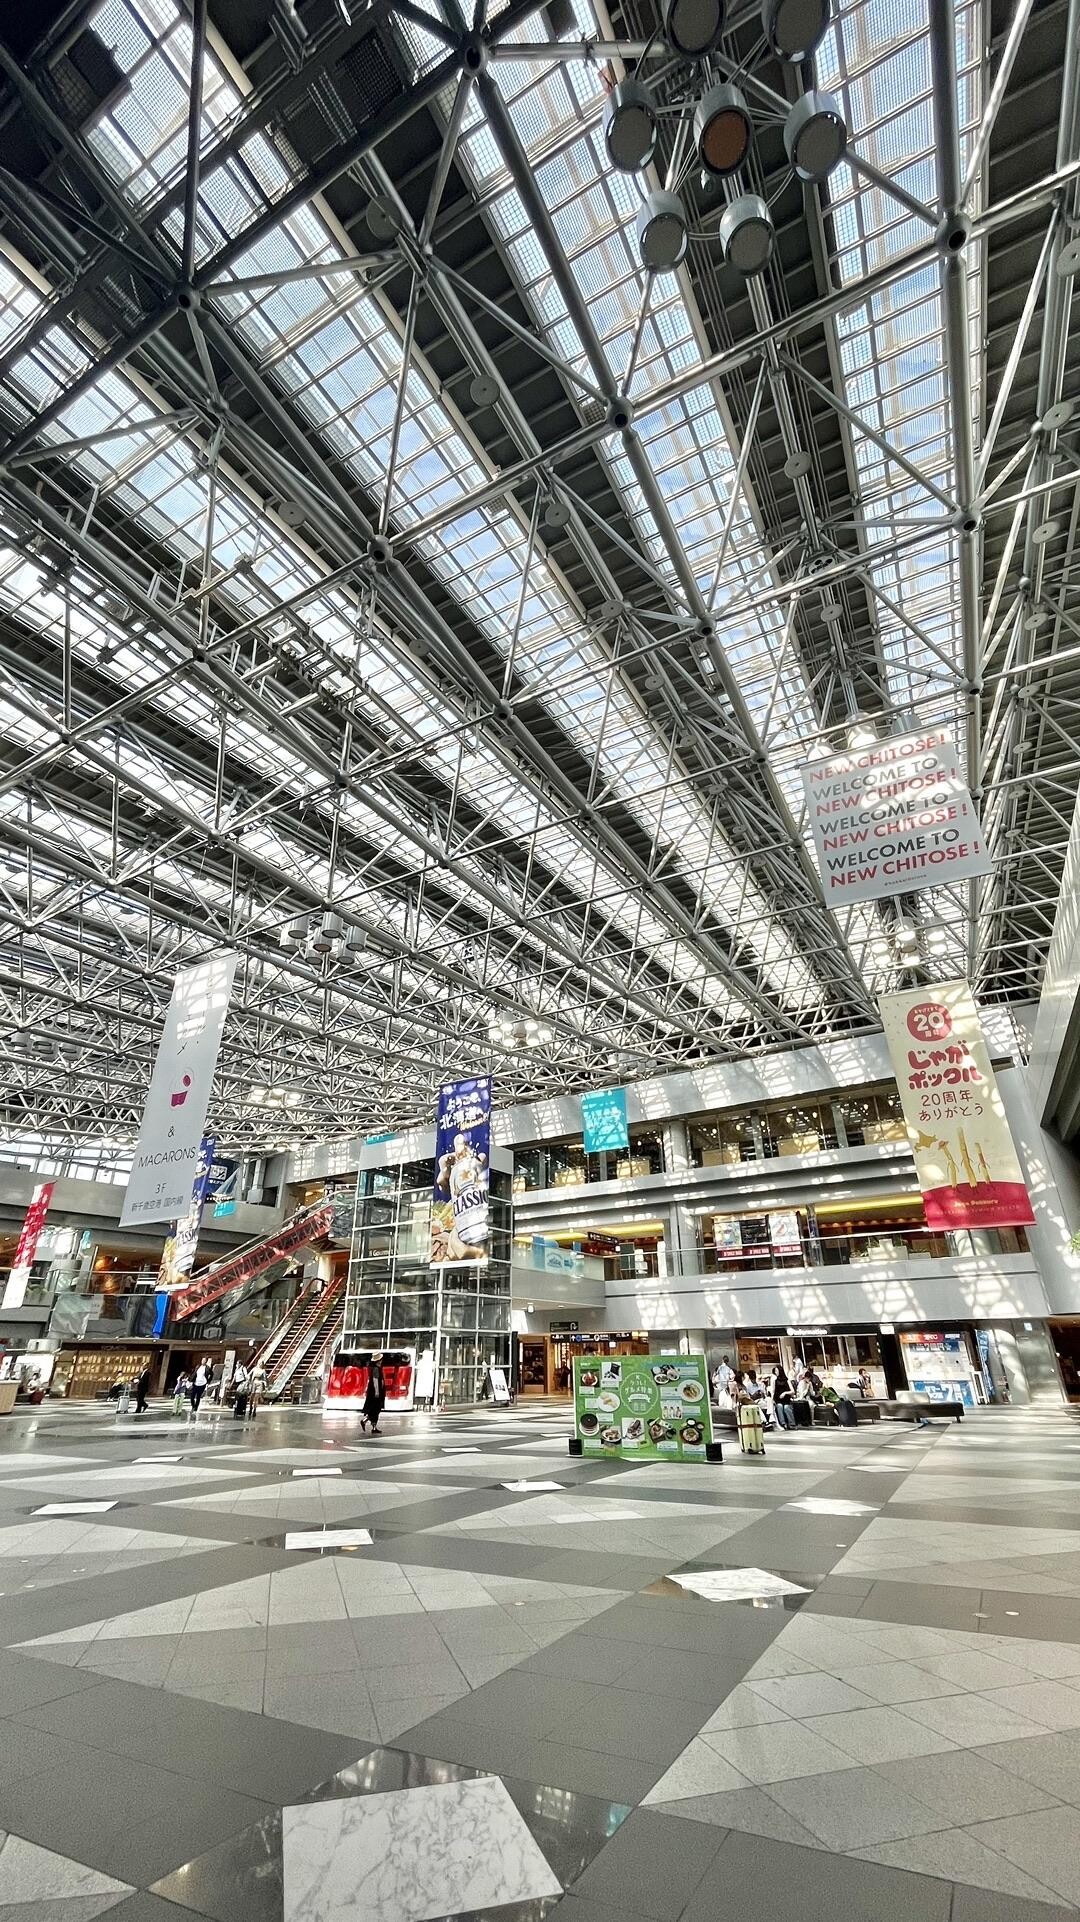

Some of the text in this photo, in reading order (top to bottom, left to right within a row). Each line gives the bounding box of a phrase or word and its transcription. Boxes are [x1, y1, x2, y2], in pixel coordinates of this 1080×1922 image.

[809, 758, 856, 783] NEW
[813, 757, 938, 801] WELCOME TO
[816, 793, 861, 816] NEW
[820, 792, 949, 835] WELCOME TO
[823, 828, 870, 851] NEW
[827, 828, 960, 871] WELCOME TO
[830, 865, 877, 888] NEW
[913, 1012, 945, 1032] 20
[908, 1040, 970, 1070] じゃが
[908, 1065, 983, 1090] ポックル
[921, 1089, 974, 1107] 20周年
[918, 1103, 985, 1122] ありがとう
[167, 1126, 175, 1138] &
[138, 1146, 197, 1168] MACARONS
[155, 1182, 168, 1194] 3F
[453, 1189, 489, 1217] CLASSIC
